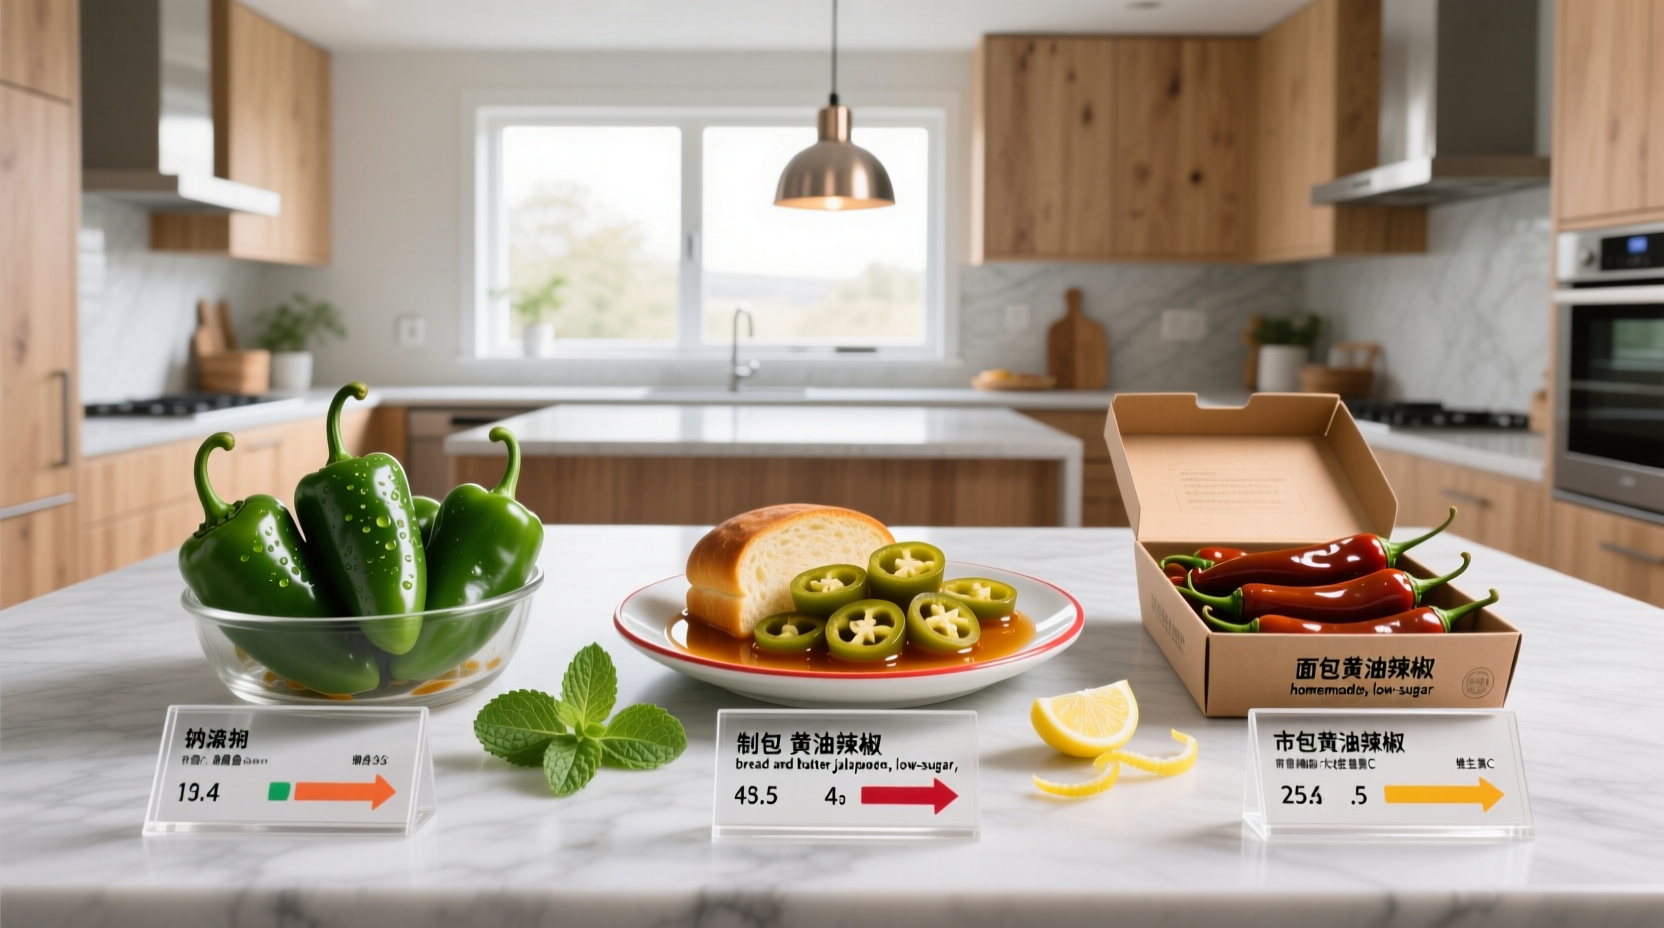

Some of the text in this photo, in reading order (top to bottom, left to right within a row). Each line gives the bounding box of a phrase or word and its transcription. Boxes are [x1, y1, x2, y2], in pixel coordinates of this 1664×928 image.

[1296, 655, 1435, 680] 面包黄油辣椒
[790, 731, 882, 756] 黄油辣椒
[1273, 729, 1405, 754] 市包黄油辣椒
[735, 757, 769, 770] bread
[178, 782, 220, 802] 19.4
